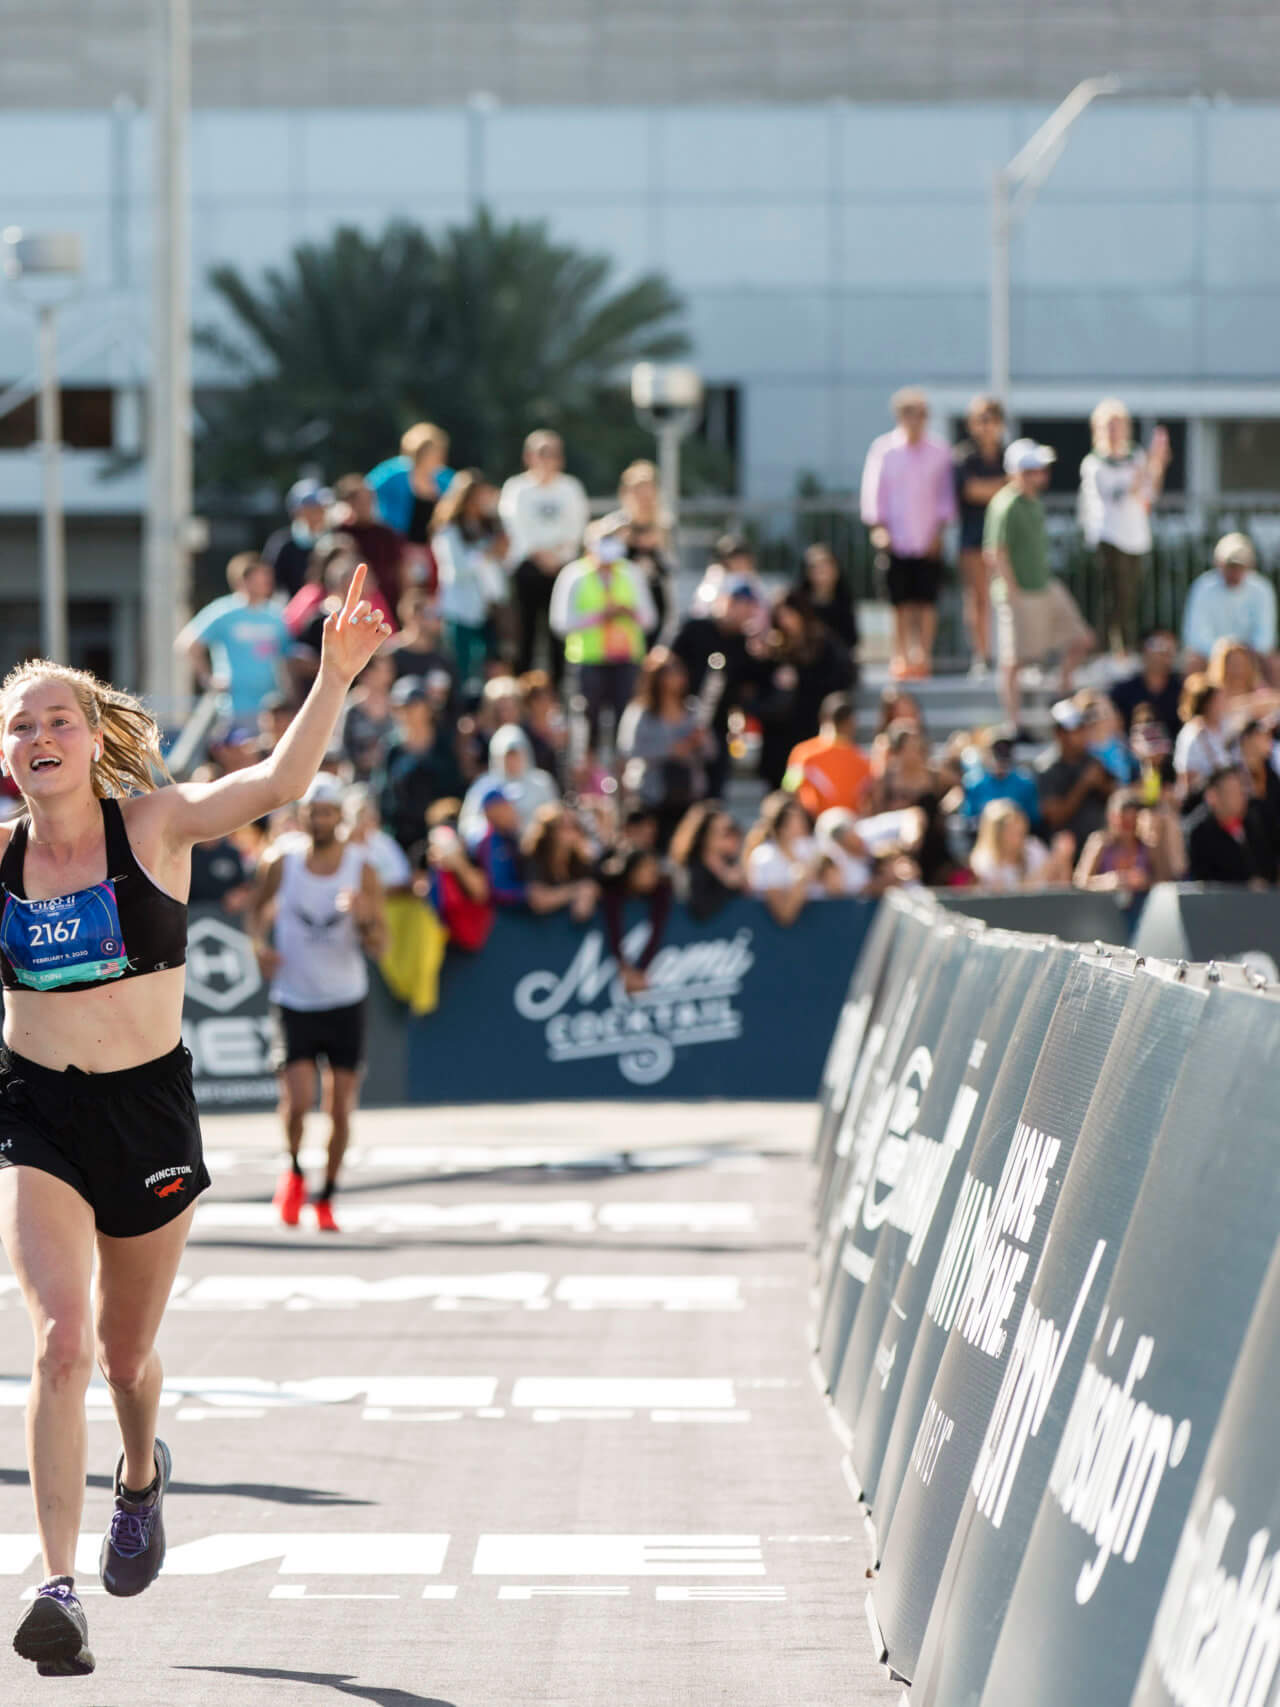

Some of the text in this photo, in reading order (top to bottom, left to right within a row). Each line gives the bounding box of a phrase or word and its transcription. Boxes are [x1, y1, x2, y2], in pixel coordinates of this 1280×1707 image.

[28, 918, 81, 947] 2167
[32, 954, 64, 964] FEBRUARY
[72, 950, 89, 958] 2020
[144, 1165, 192, 1189] PRINCETON
[269, 1584, 787, 1602] LIFE
